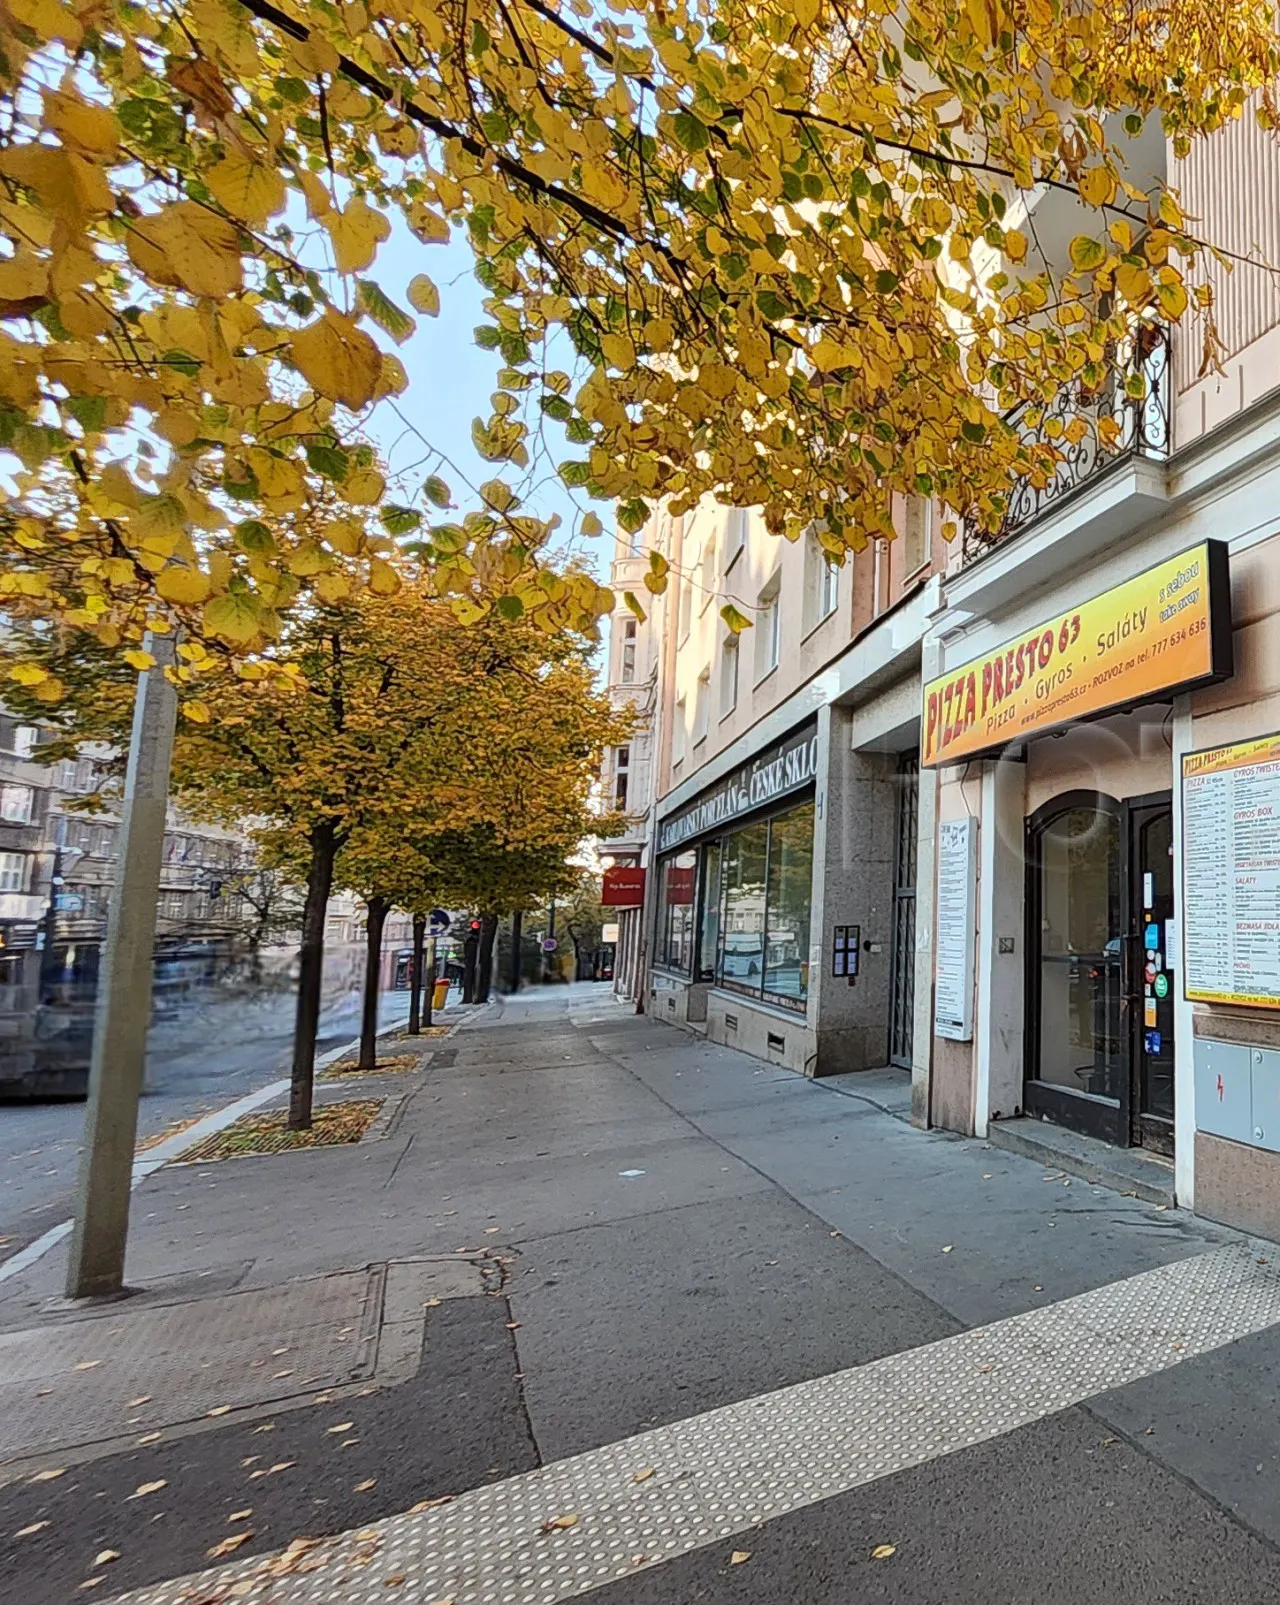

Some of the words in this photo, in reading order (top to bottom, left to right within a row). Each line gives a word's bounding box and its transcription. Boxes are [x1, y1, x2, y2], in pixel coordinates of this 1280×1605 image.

[1166, 561, 1200, 598] sebou
[1159, 604, 1177, 623] take
[1177, 588, 1200, 612] away
[1091, 663, 1123, 688] ROZVOZ
[1125, 659, 1135, 671] na
[1151, 637, 1168, 658] 777
[1170, 628, 1187, 647] 634
[1188, 617, 1207, 637] 636
[926, 671, 976, 760] PIZZA
[980, 630, 1054, 719] PRESTO
[1058, 614, 1081, 654] 63
[986, 704, 1016, 736] Pizza
[1035, 663, 1073, 700] Gyros
[1097, 606, 1148, 657] Saláty
[749, 746, 785, 805] ČESKÉ
[784, 734, 819, 790] SKLO
[1185, 755, 1205, 776] PIZZA
[1186, 777, 1205, 789] PIZZA
[1234, 766, 1255, 778] GYROS
[1234, 809, 1256, 820] GYROS
[1257, 806, 1273, 817] BOX
